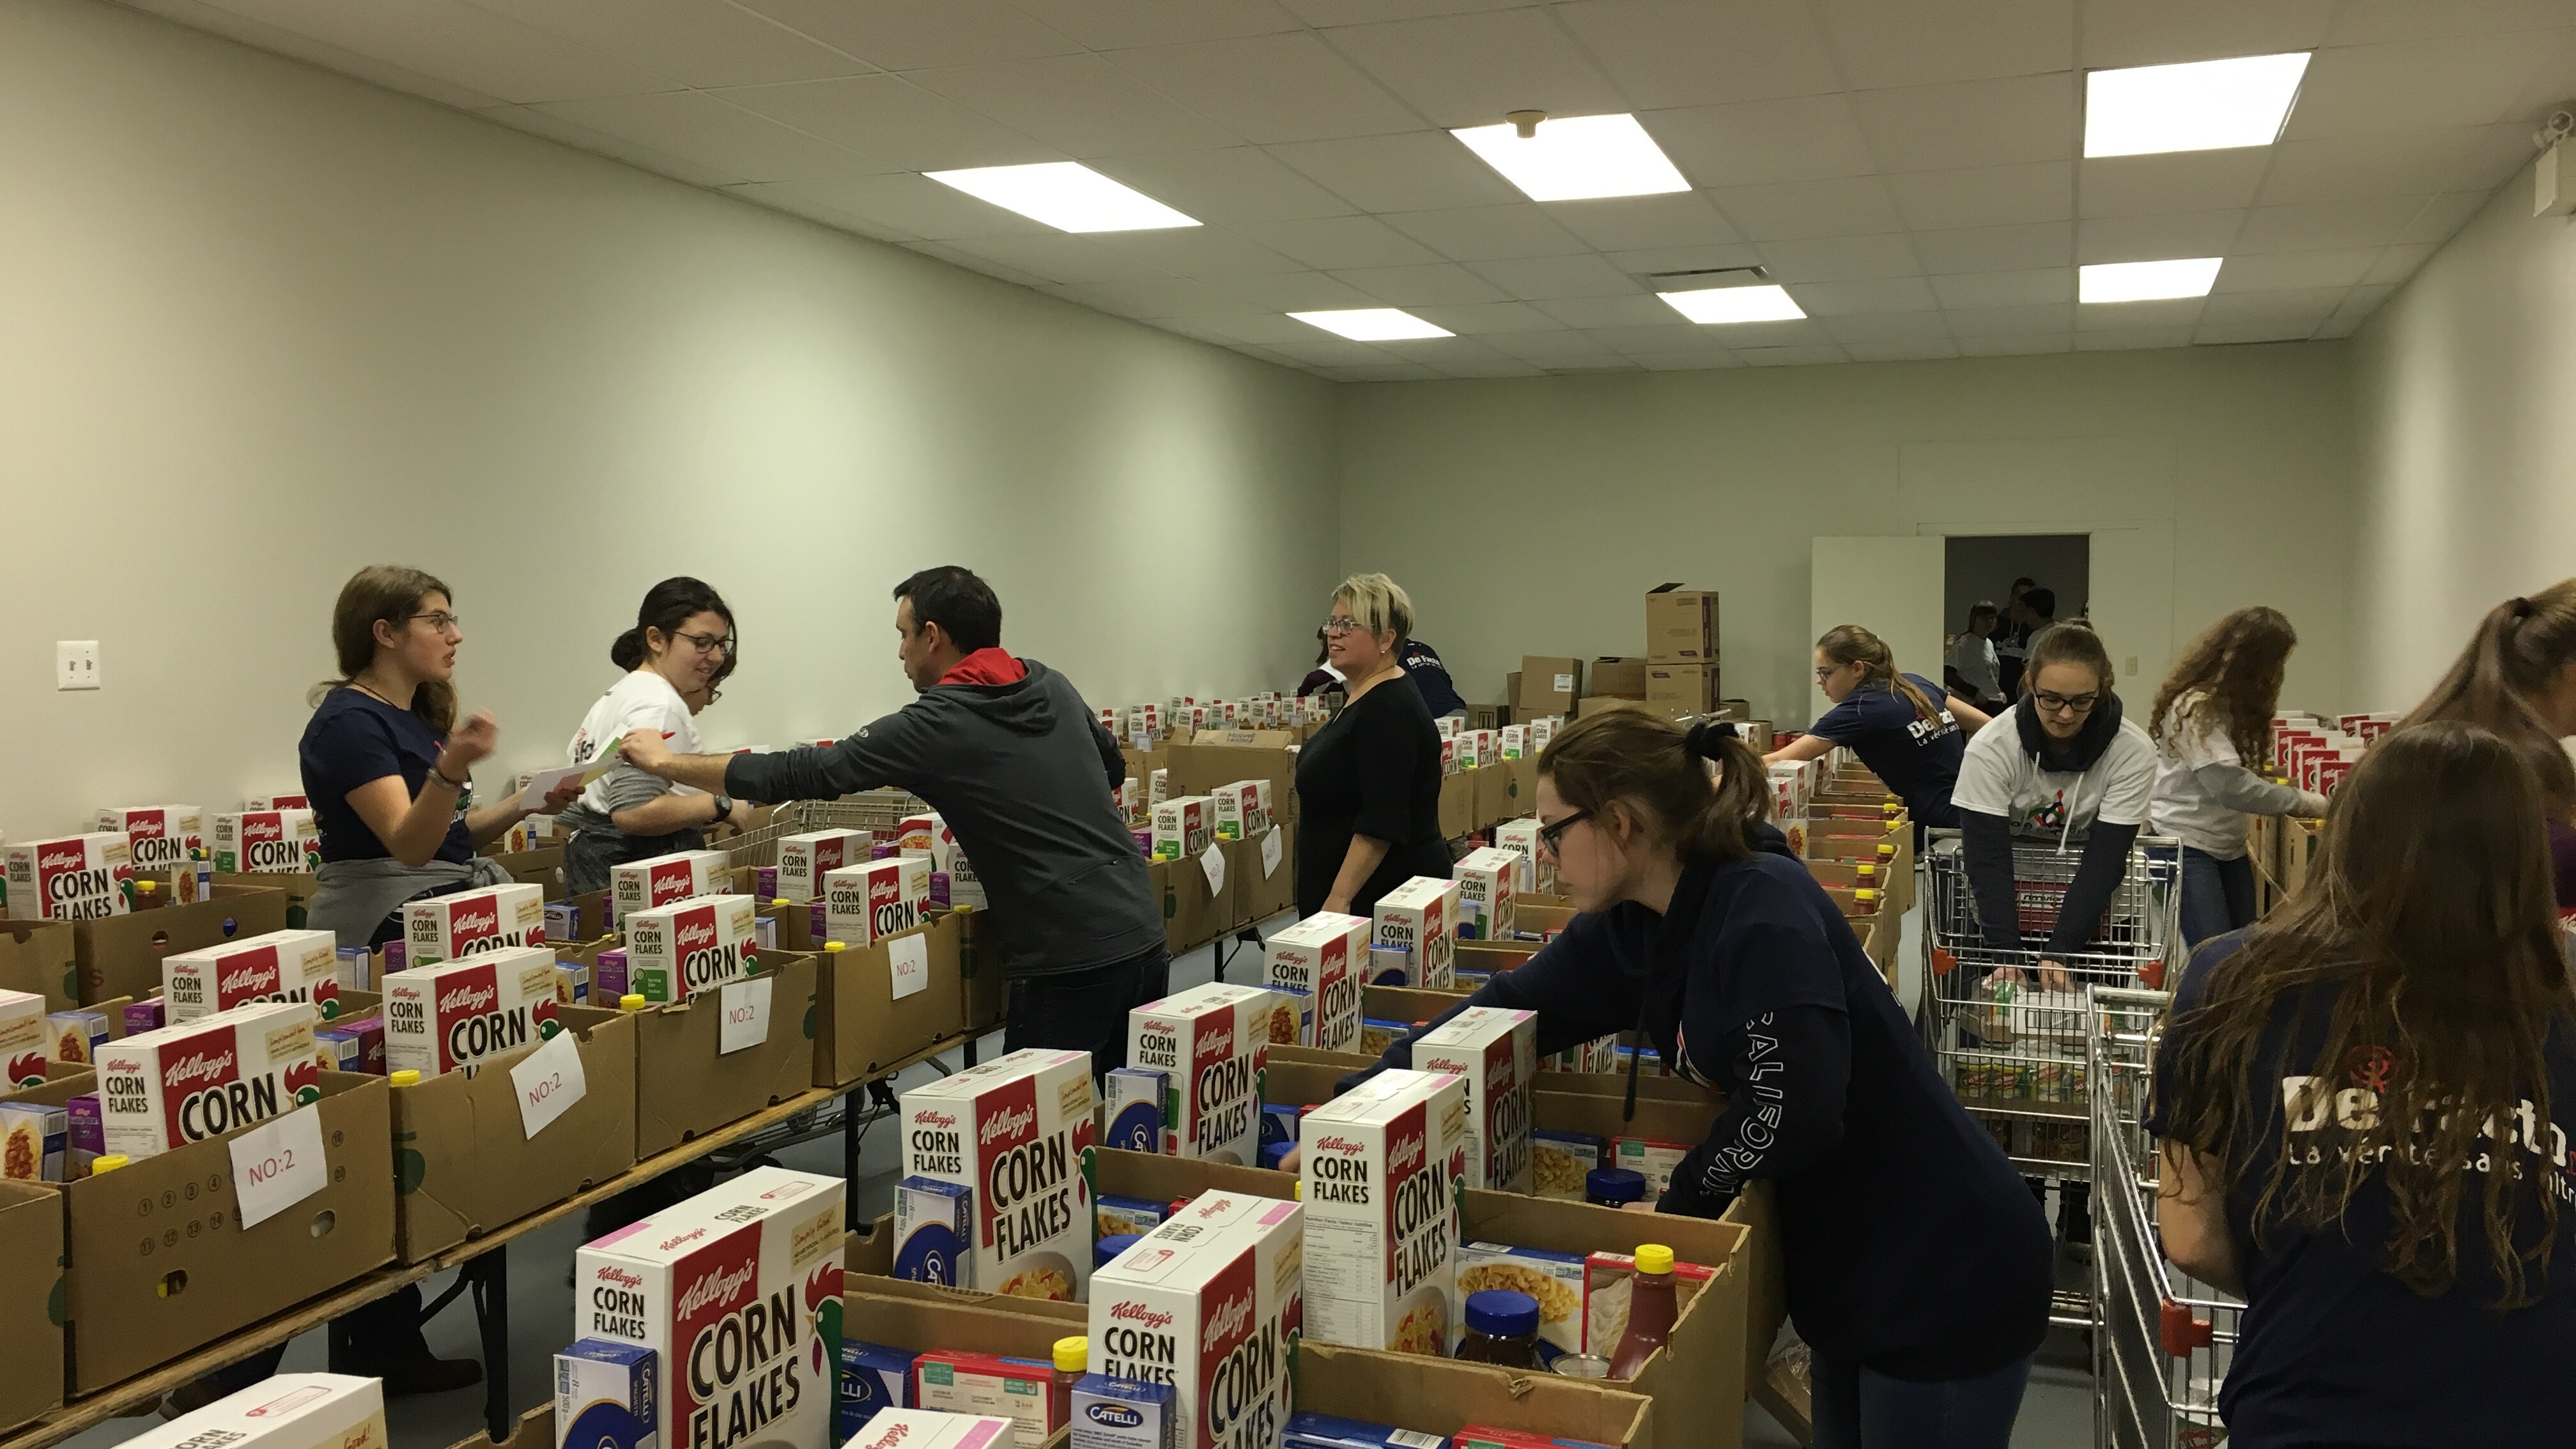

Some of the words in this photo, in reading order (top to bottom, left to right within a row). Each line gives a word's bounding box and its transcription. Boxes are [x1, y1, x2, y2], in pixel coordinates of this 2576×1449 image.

[1906, 719, 1935, 739] De
[1444, 760, 1457, 773] CORN
[1480, 750, 1493, 765] CORN
[128, 820, 162, 834] Kellogg's
[216, 824, 233, 833] CORN
[1247, 808, 1266, 831] CORN
[244, 822, 279, 837] Kellogg's
[1189, 827, 1209, 853] CORN
[1503, 844, 1529, 855] CORN
[134, 838, 181, 862] CORN
[251, 839, 298, 866] CORN
[785, 846, 806, 855] Kellogg's
[817, 849, 842, 864] Kellogg's
[9, 862, 30, 871] CORN
[41, 852, 82, 869] Kellogg's
[782, 855, 807, 867] CORN
[954, 861, 971, 871] COR
[10, 873, 31, 882] FLAKES
[782, 867, 807, 877] FLAKES
[50, 868, 109, 900] CORN
[618, 880, 640, 891] CORN
[654, 874, 690, 894] Kellogg's
[833, 879, 857, 889] Kellogg's
[870, 880, 898, 899] Kellogg's
[1461, 880, 1486, 893] CORN
[619, 892, 641, 901] FLAKES
[831, 891, 860, 903] CORN
[1460, 891, 1486, 901] FLAKES
[54, 896, 112, 919] FLAKES
[832, 904, 860, 914] FLAKES
[412, 920, 438, 931] CORN
[454, 911, 495, 933] Kellogg's
[636, 919, 659, 929] Kellogg's
[876, 900, 914, 936] CORN
[1384, 913, 1412, 925] Kellogg's
[413, 932, 438, 942] FLAKES
[635, 931, 661, 943] CORN
[677, 923, 714, 946] Kellogg's
[1381, 924, 1414, 940] CORN
[635, 944, 662, 954] FLAKES
[1276, 951, 1308, 965] Kellogg's
[1427, 929, 1450, 973] CORN
[686, 943, 736, 987] CORN
[897, 960, 916, 977] NO:2
[1272, 963, 1308, 982] CORN
[1321, 953, 1346, 979] Kellogg's
[173, 977, 201, 990] CORN
[222, 966, 276, 993] Kellogg's
[173, 992, 203, 1004] FLAKES
[392, 988, 420, 999] Kellogg's
[440, 985, 495, 1013] Kellogg's
[1323, 972, 1357, 1022] CORN
[390, 1002, 423, 1018] CORN
[730, 1006, 754, 1025] NO:2
[391, 1020, 424, 1034] FLAKES
[451, 1006, 527, 1060] CORN
[1143, 1020, 1175, 1035] Kellogg's
[1321, 1011, 1355, 1051] FLAKES
[1140, 1034, 1176, 1053] CORN
[1196, 1028, 1232, 1058] Kellogg's
[107, 1059, 141, 1073] Kellogg's
[166, 1050, 233, 1086] Kellogg's
[1140, 1051, 1176, 1068] FLAKES
[1426, 1058, 1468, 1074] Kellogg's
[106, 1077, 146, 1095] CORN
[528, 1072, 562, 1107] NO:2
[1200, 1054, 1249, 1112] CORN
[109, 1097, 148, 1114] FLAKES
[182, 1073, 278, 1140] CORN
[914, 1110, 956, 1128] Kellogg's
[981, 1103, 1034, 1145] Kellogg's
[1493, 1084, 1527, 1149] CORN
[1198, 1101, 1247, 1156] FLAKES
[912, 1130, 960, 1153] CORN
[1317, 1136, 1364, 1156] Kellogg's
[1388, 1130, 1424, 1174] Kellogg's
[1493, 1129, 1527, 1190] FLAKES
[249, 1149, 295, 1186] NO:2
[914, 1155, 961, 1174] FLAKES
[992, 1130, 1068, 1208] CORN
[1313, 1156, 1368, 1183] CORN
[1314, 1181, 1369, 1205] FLAKES
[1394, 1158, 1444, 1241] CORN
[714, 1205, 752, 1221] CORN
[730, 1206, 769, 1223] FLAKES
[996, 1187, 1070, 1262] FLAKES
[659, 1227, 707, 1251] Kellogg's
[1396, 1218, 1446, 1298] FLAKES
[598, 1266, 643, 1289] Kellogg's
[677, 1258, 755, 1322] Kellogg's
[594, 1287, 644, 1317] CORN
[1111, 1301, 1173, 1329] Kellogg's
[1204, 1286, 1254, 1353] Kellogg's
[594, 1312, 645, 1340] FLAKES
[691, 1283, 796, 1397] CORN
[1105, 1326, 1175, 1364] CORN
[1105, 1358, 1176, 1386] FLAKES
[1211, 1314, 1276, 1434] CORN
[642, 1368, 651, 1416] CATELLI
[1108, 1382, 1141, 1392] CATELLI
[694, 1356, 800, 1449] FLAKES
[1090, 1406, 1137, 1425] CATELLI
